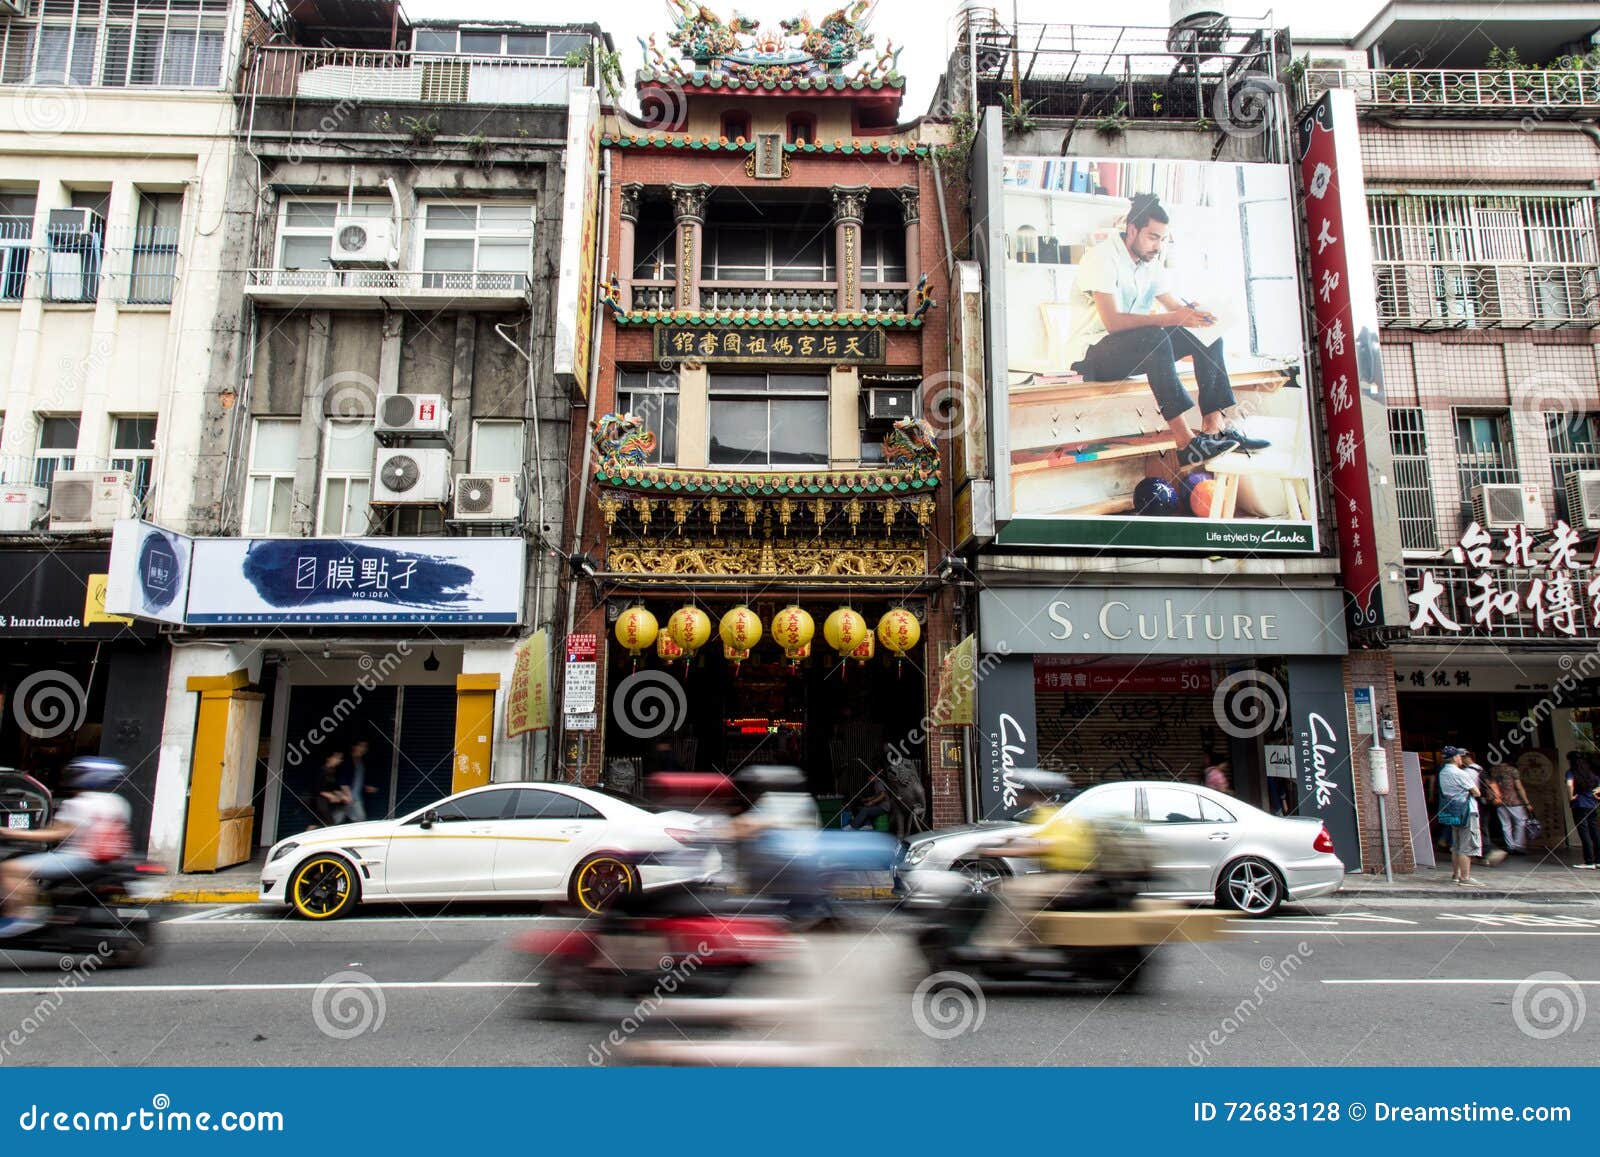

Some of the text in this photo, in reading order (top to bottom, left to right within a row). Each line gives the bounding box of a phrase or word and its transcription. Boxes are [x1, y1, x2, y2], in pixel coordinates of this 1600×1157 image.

[1317, 217, 1358, 471] 太和傳統餅
[1206, 529, 1306, 544] Life styled by Clarks
[1460, 519, 1600, 569] 台北老
[10, 615, 81, 628] handmade
[352, 591, 389, 599] MO IDEA
[1408, 570, 1600, 636] 太和傳
[990, 732, 1000, 793] ENGLAND
[1000, 713, 1026, 807] Clarks
[1301, 731, 1313, 792] ENGLAND
[1308, 712, 1336, 807] Clarks
